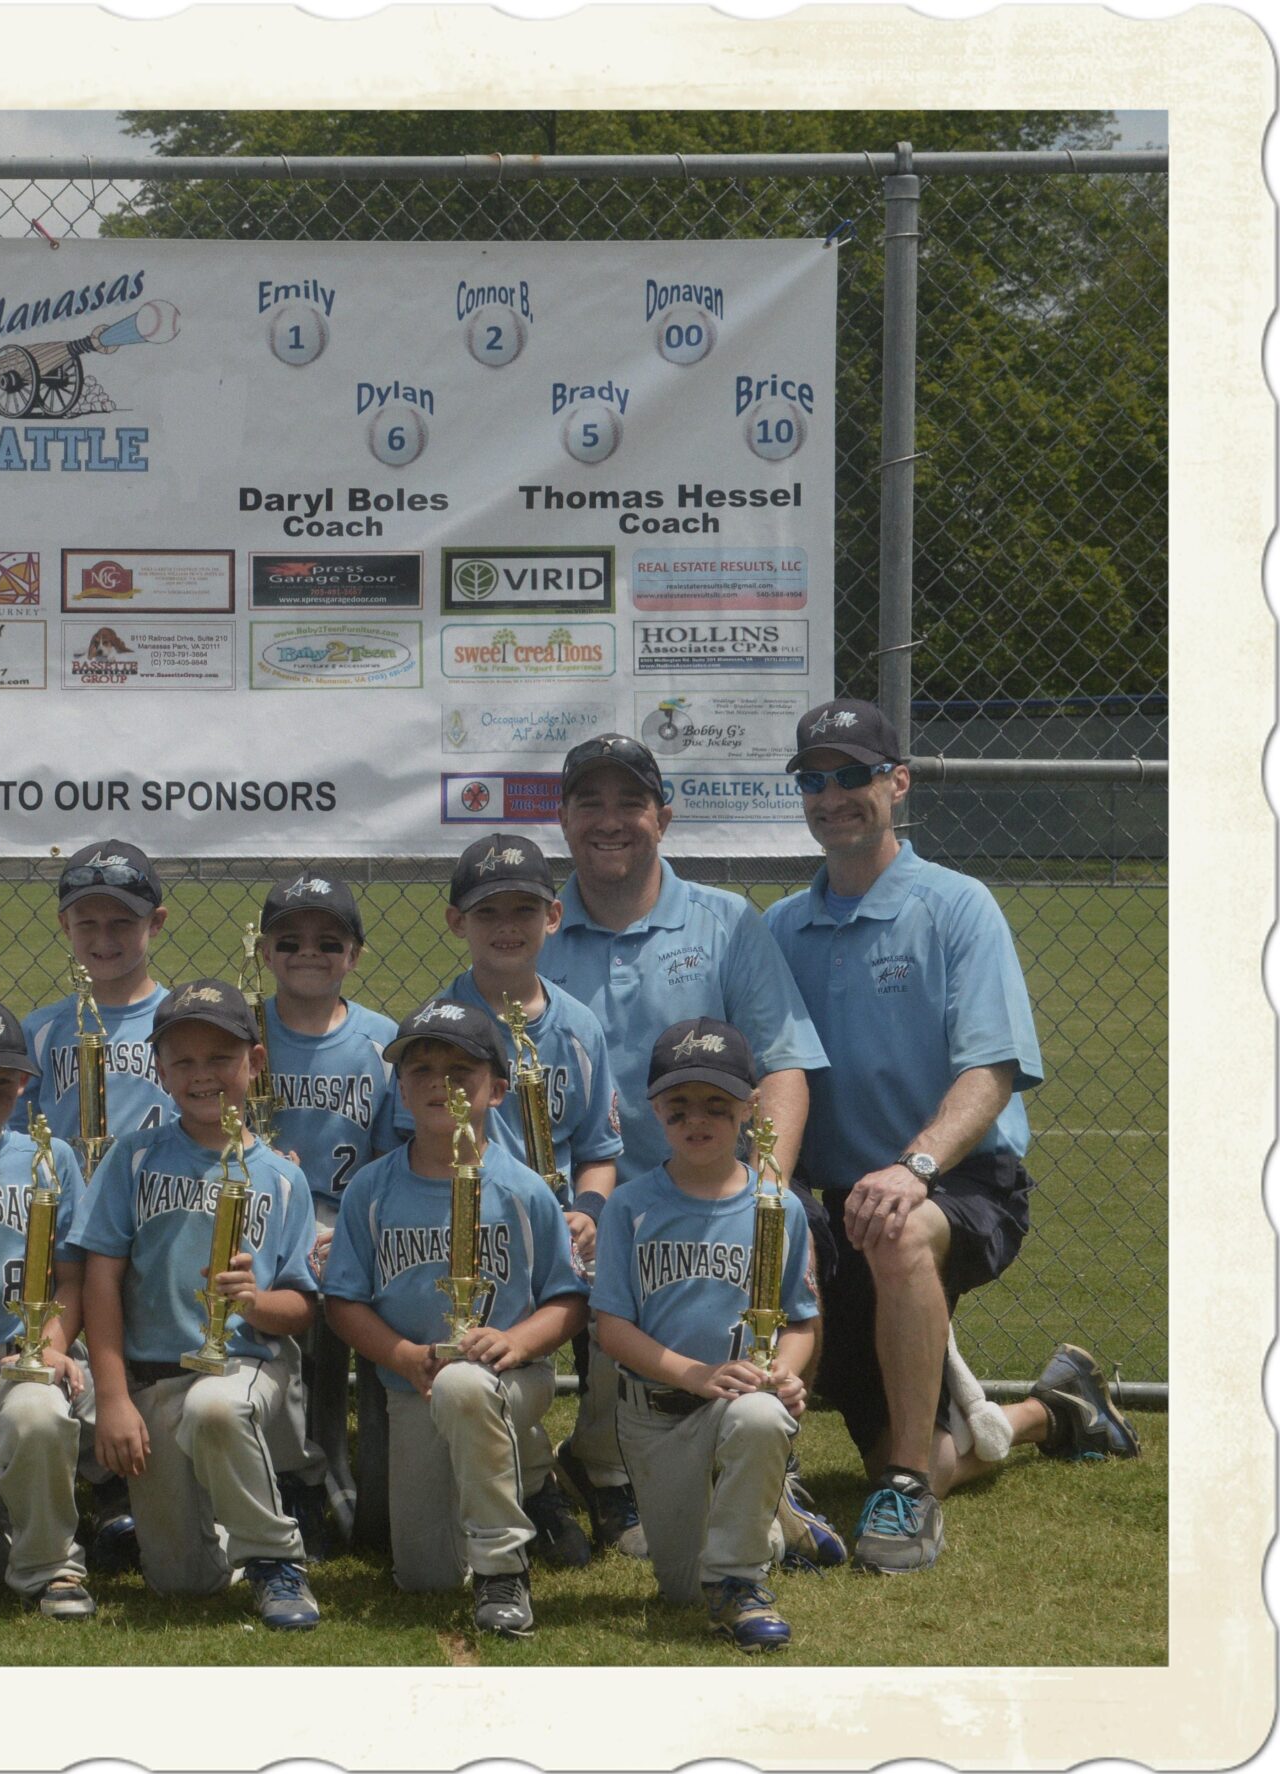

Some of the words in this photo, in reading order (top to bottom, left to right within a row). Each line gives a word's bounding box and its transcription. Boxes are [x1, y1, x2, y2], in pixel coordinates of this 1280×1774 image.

[259, 280, 335, 316] Emily
[457, 281, 516, 321] Connor
[646, 279, 723, 322] Donavan
[289, 325, 304, 349] 1
[486, 326, 502, 350] 2
[665, 324, 703, 348] 00
[358, 381, 434, 415] Dylan
[552, 381, 629, 414] Brady
[736, 374, 814, 416] Brice
[388, 427, 405, 451] 6
[582, 424, 599, 447] 5
[757, 420, 794, 443] 10
[240, 487, 333, 515] Daryl
[348, 488, 449, 511] Boles
[519, 486, 664, 509] Thomas
[678, 483, 802, 507] Hessel
[283, 516, 384, 538] Coach
[620, 513, 720, 534] Coach
[638, 562, 669, 573] REAL
[673, 561, 717, 572] ESTATE
[720, 560, 777, 573] RESULTS,
[781, 560, 801, 571] LLC
[269, 574, 340, 585] Garage
[348, 574, 397, 583] Door
[503, 568, 603, 591] VIRID
[640, 626, 779, 643] HOLLINS
[454, 637, 508, 663] sweet
[513, 637, 603, 663] creations
[641, 643, 725, 654] Associates
[731, 642, 778, 653] CPAs
[72, 661, 138, 671] BASSETTE
[81, 674, 128, 683] GROUP
[530, 712, 559, 727] Lodge
[682, 725, 723, 738] Bobby
[54, 780, 131, 811] OUR
[141, 780, 337, 812] SPONSORS
[681, 779, 770, 798] GAELTEK,
[684, 798, 749, 811] Technology
[752, 798, 806, 809] Solutions
[658, 945, 704, 963] MANASSAS
[668, 972, 703, 986] BATTLE
[877, 983, 909, 994] BATTLE
[331, 1144, 358, 1193] 2
[137, 1170, 273, 1253] MANASAS
[377, 1223, 511, 1286] MANASAS
[637, 1240, 756, 1307] MANASSA
